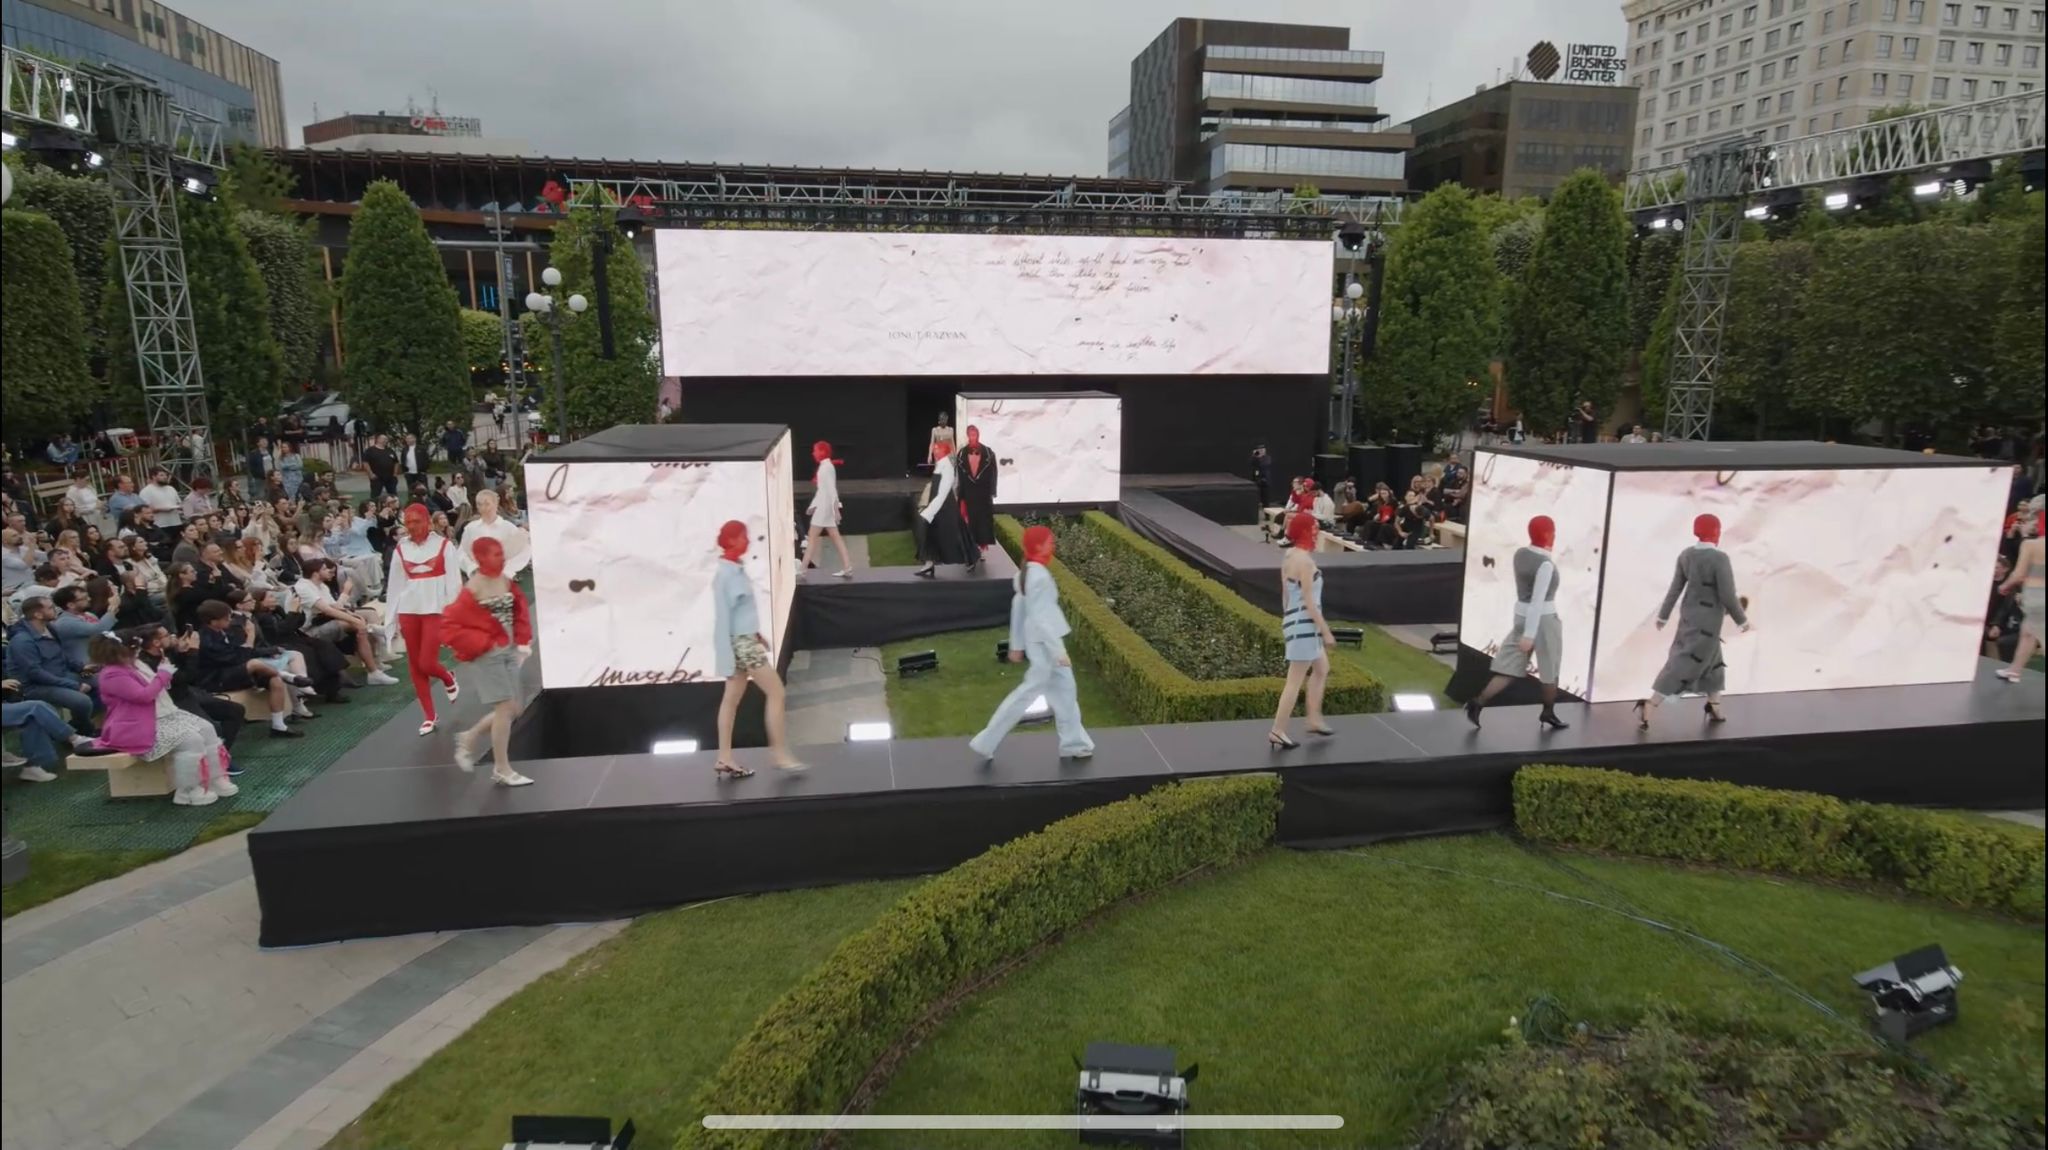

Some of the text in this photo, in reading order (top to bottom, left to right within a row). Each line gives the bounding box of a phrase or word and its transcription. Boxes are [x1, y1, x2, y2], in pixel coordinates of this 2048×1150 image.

[1572, 44, 1617, 57] UNITED
[1570, 56, 1627, 71] BUSINESS
[1569, 68, 1616, 82] CENTER
